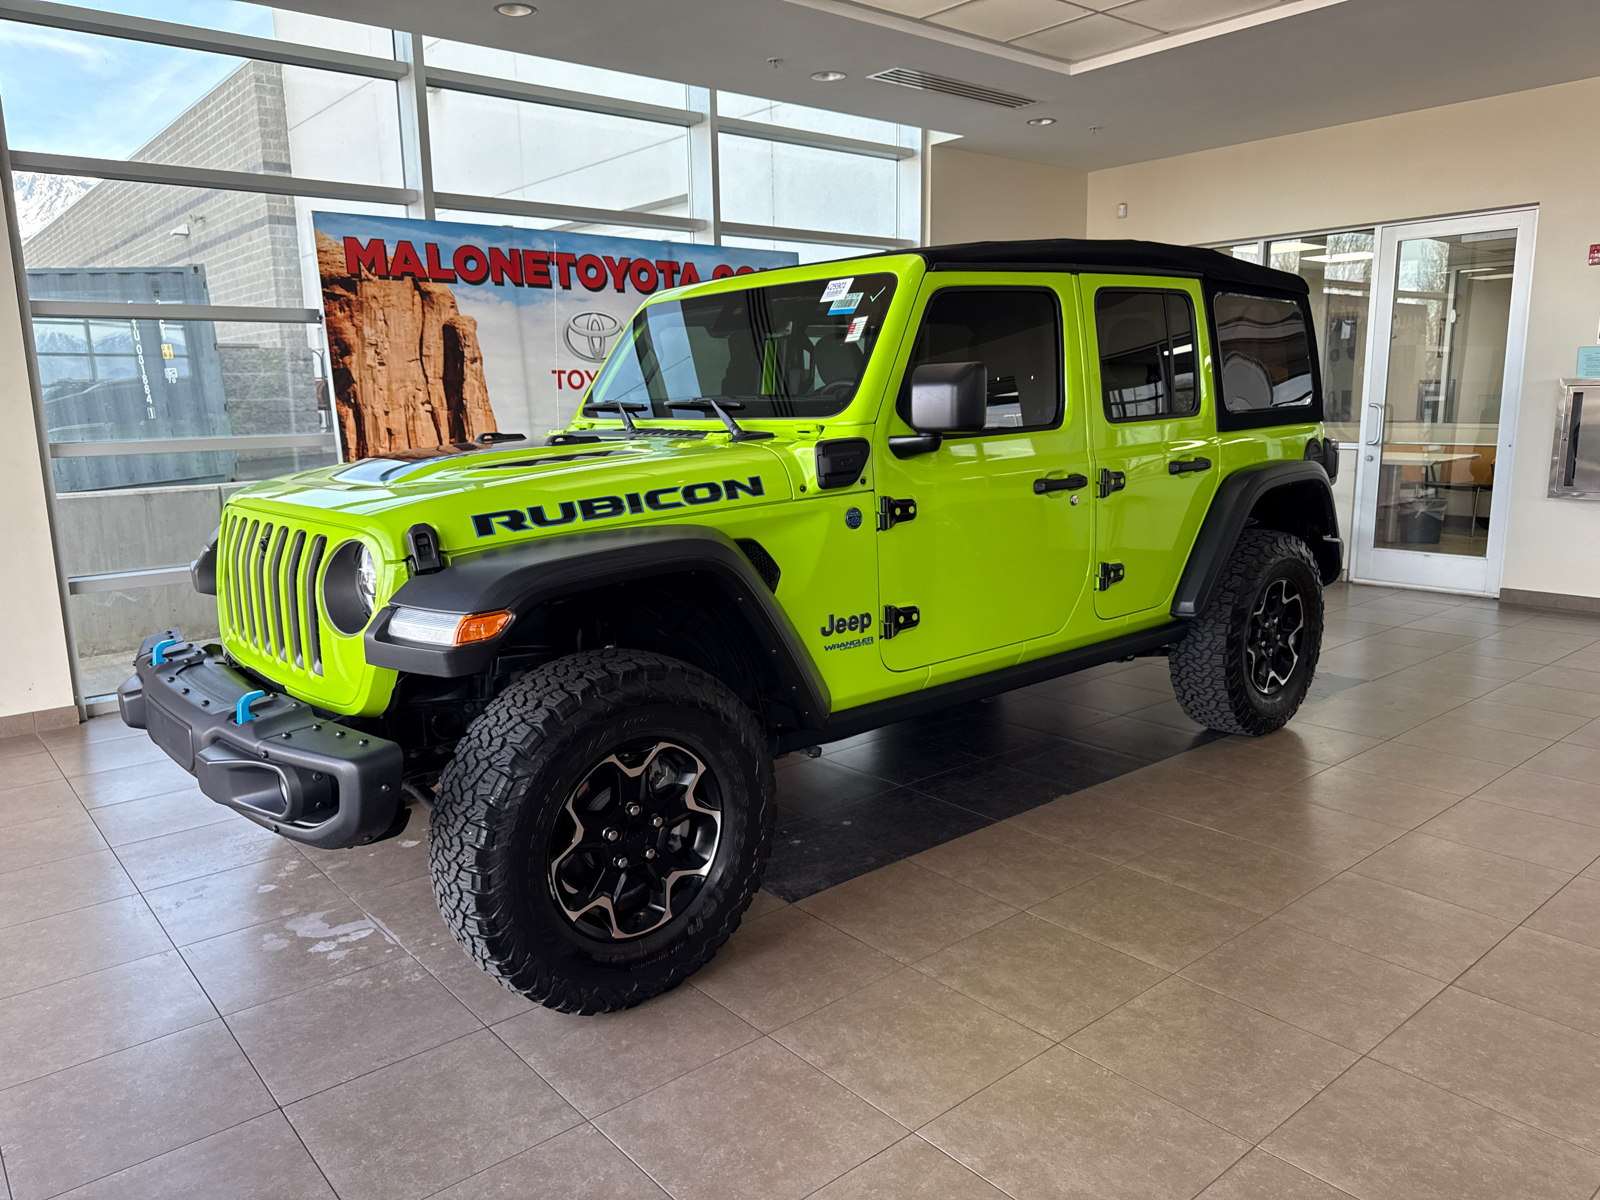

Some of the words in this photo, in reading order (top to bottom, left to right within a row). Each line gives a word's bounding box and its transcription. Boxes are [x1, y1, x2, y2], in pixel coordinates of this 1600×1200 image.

[343, 236, 769, 294] MALONETOYOTA
[551, 369, 600, 390] TOY
[471, 475, 765, 538] RUBICON
[820, 612, 872, 637] Jeep
[823, 636, 873, 651] WRANGLER
